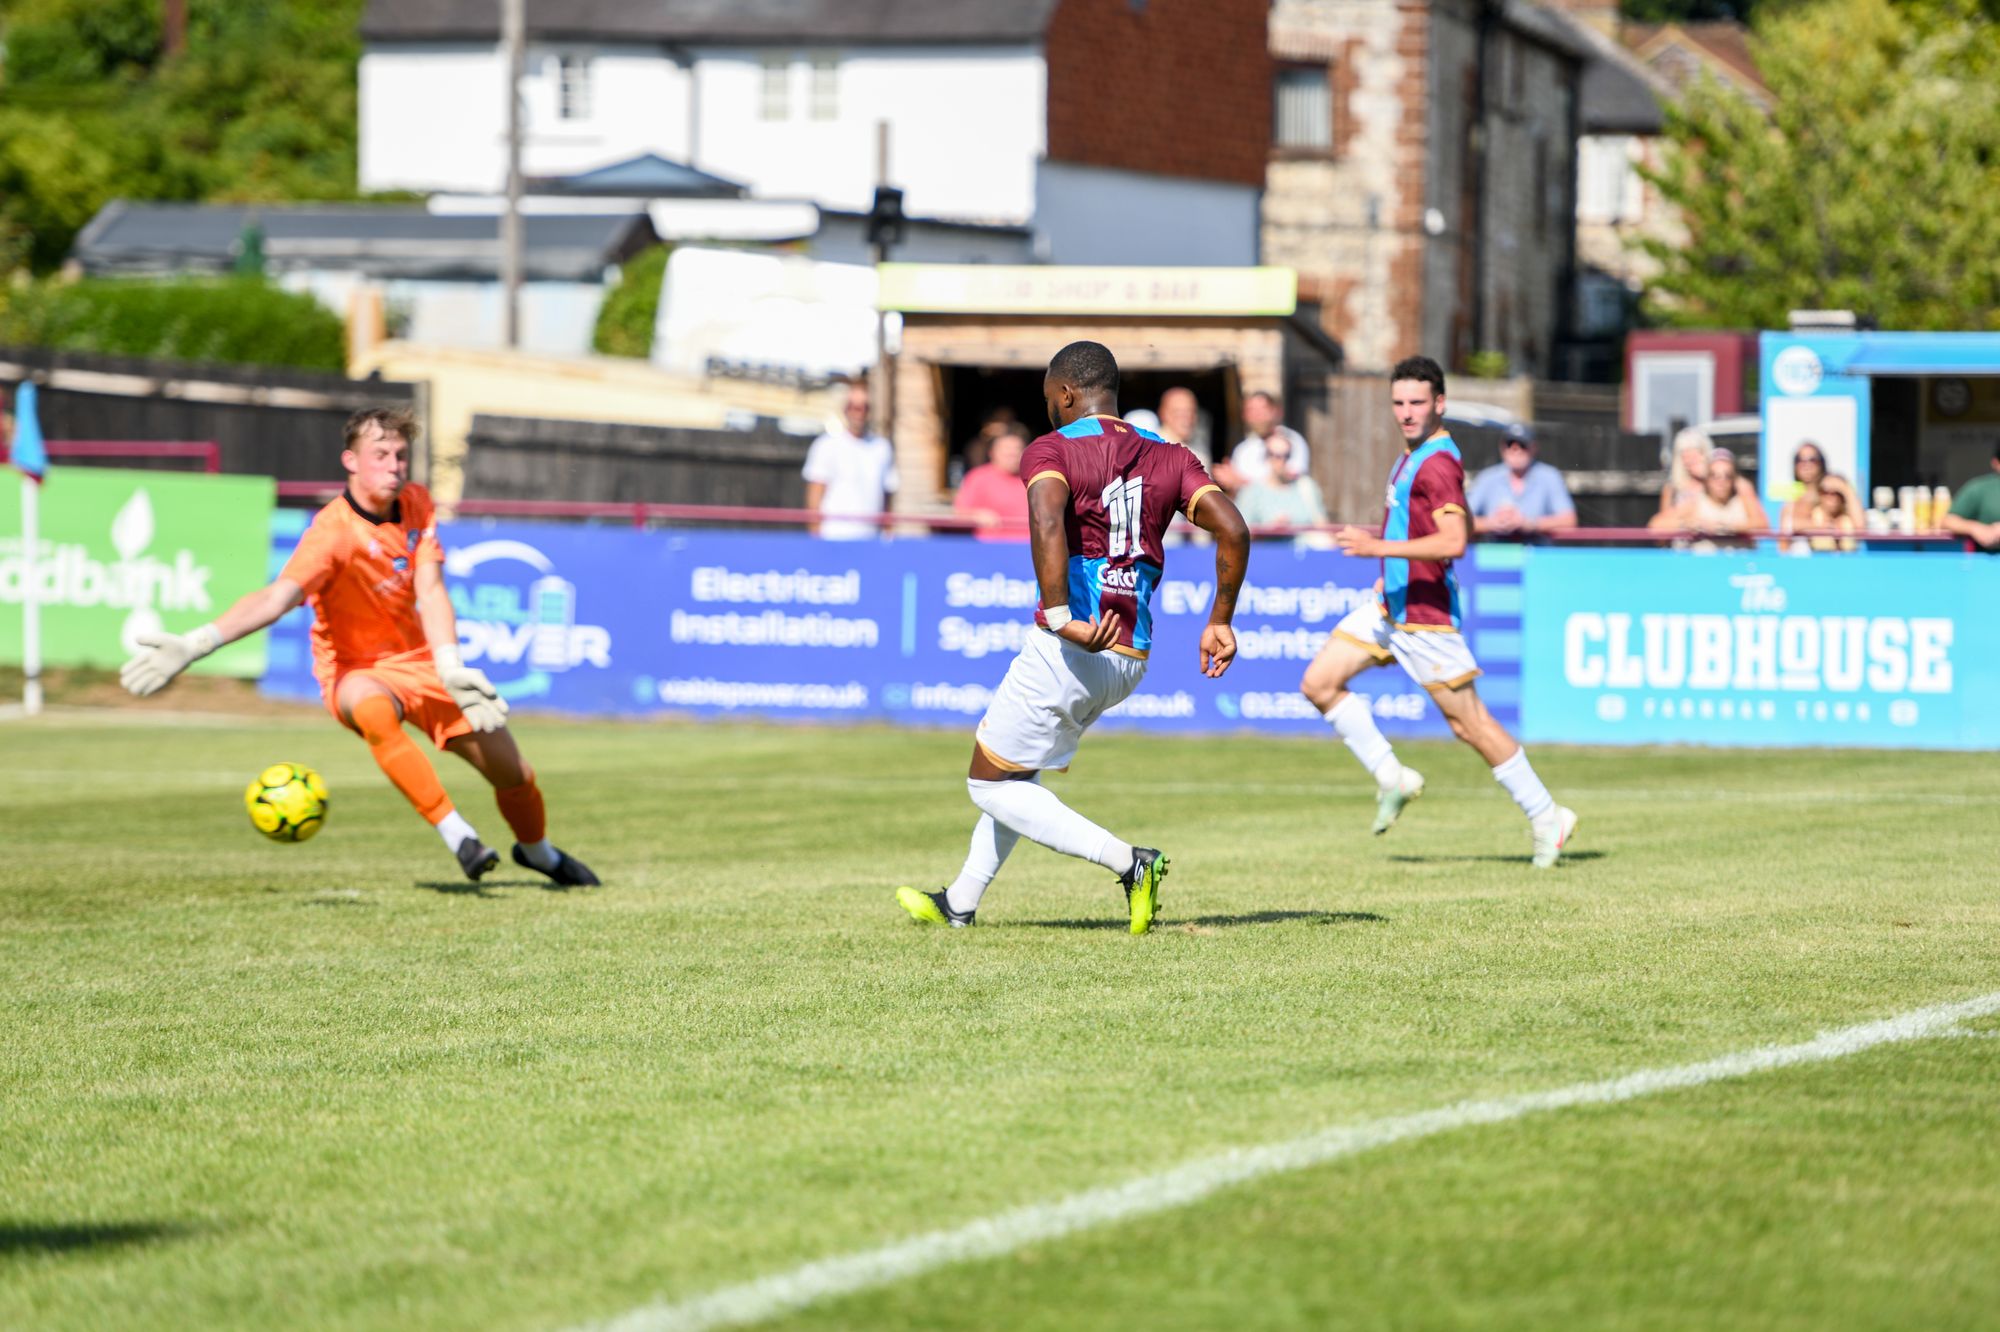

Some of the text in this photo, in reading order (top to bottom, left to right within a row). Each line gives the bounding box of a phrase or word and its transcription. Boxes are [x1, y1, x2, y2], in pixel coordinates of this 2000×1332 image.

[1102, 475, 1146, 558] 11
[691, 566, 861, 605] Electrical
[1161, 580, 1213, 615] EV
[1729, 573, 1788, 613] The
[670, 608, 879, 648] Installation
[1234, 624, 1331, 660] oints
[1564, 612, 1954, 693] CLUBHOUSE
